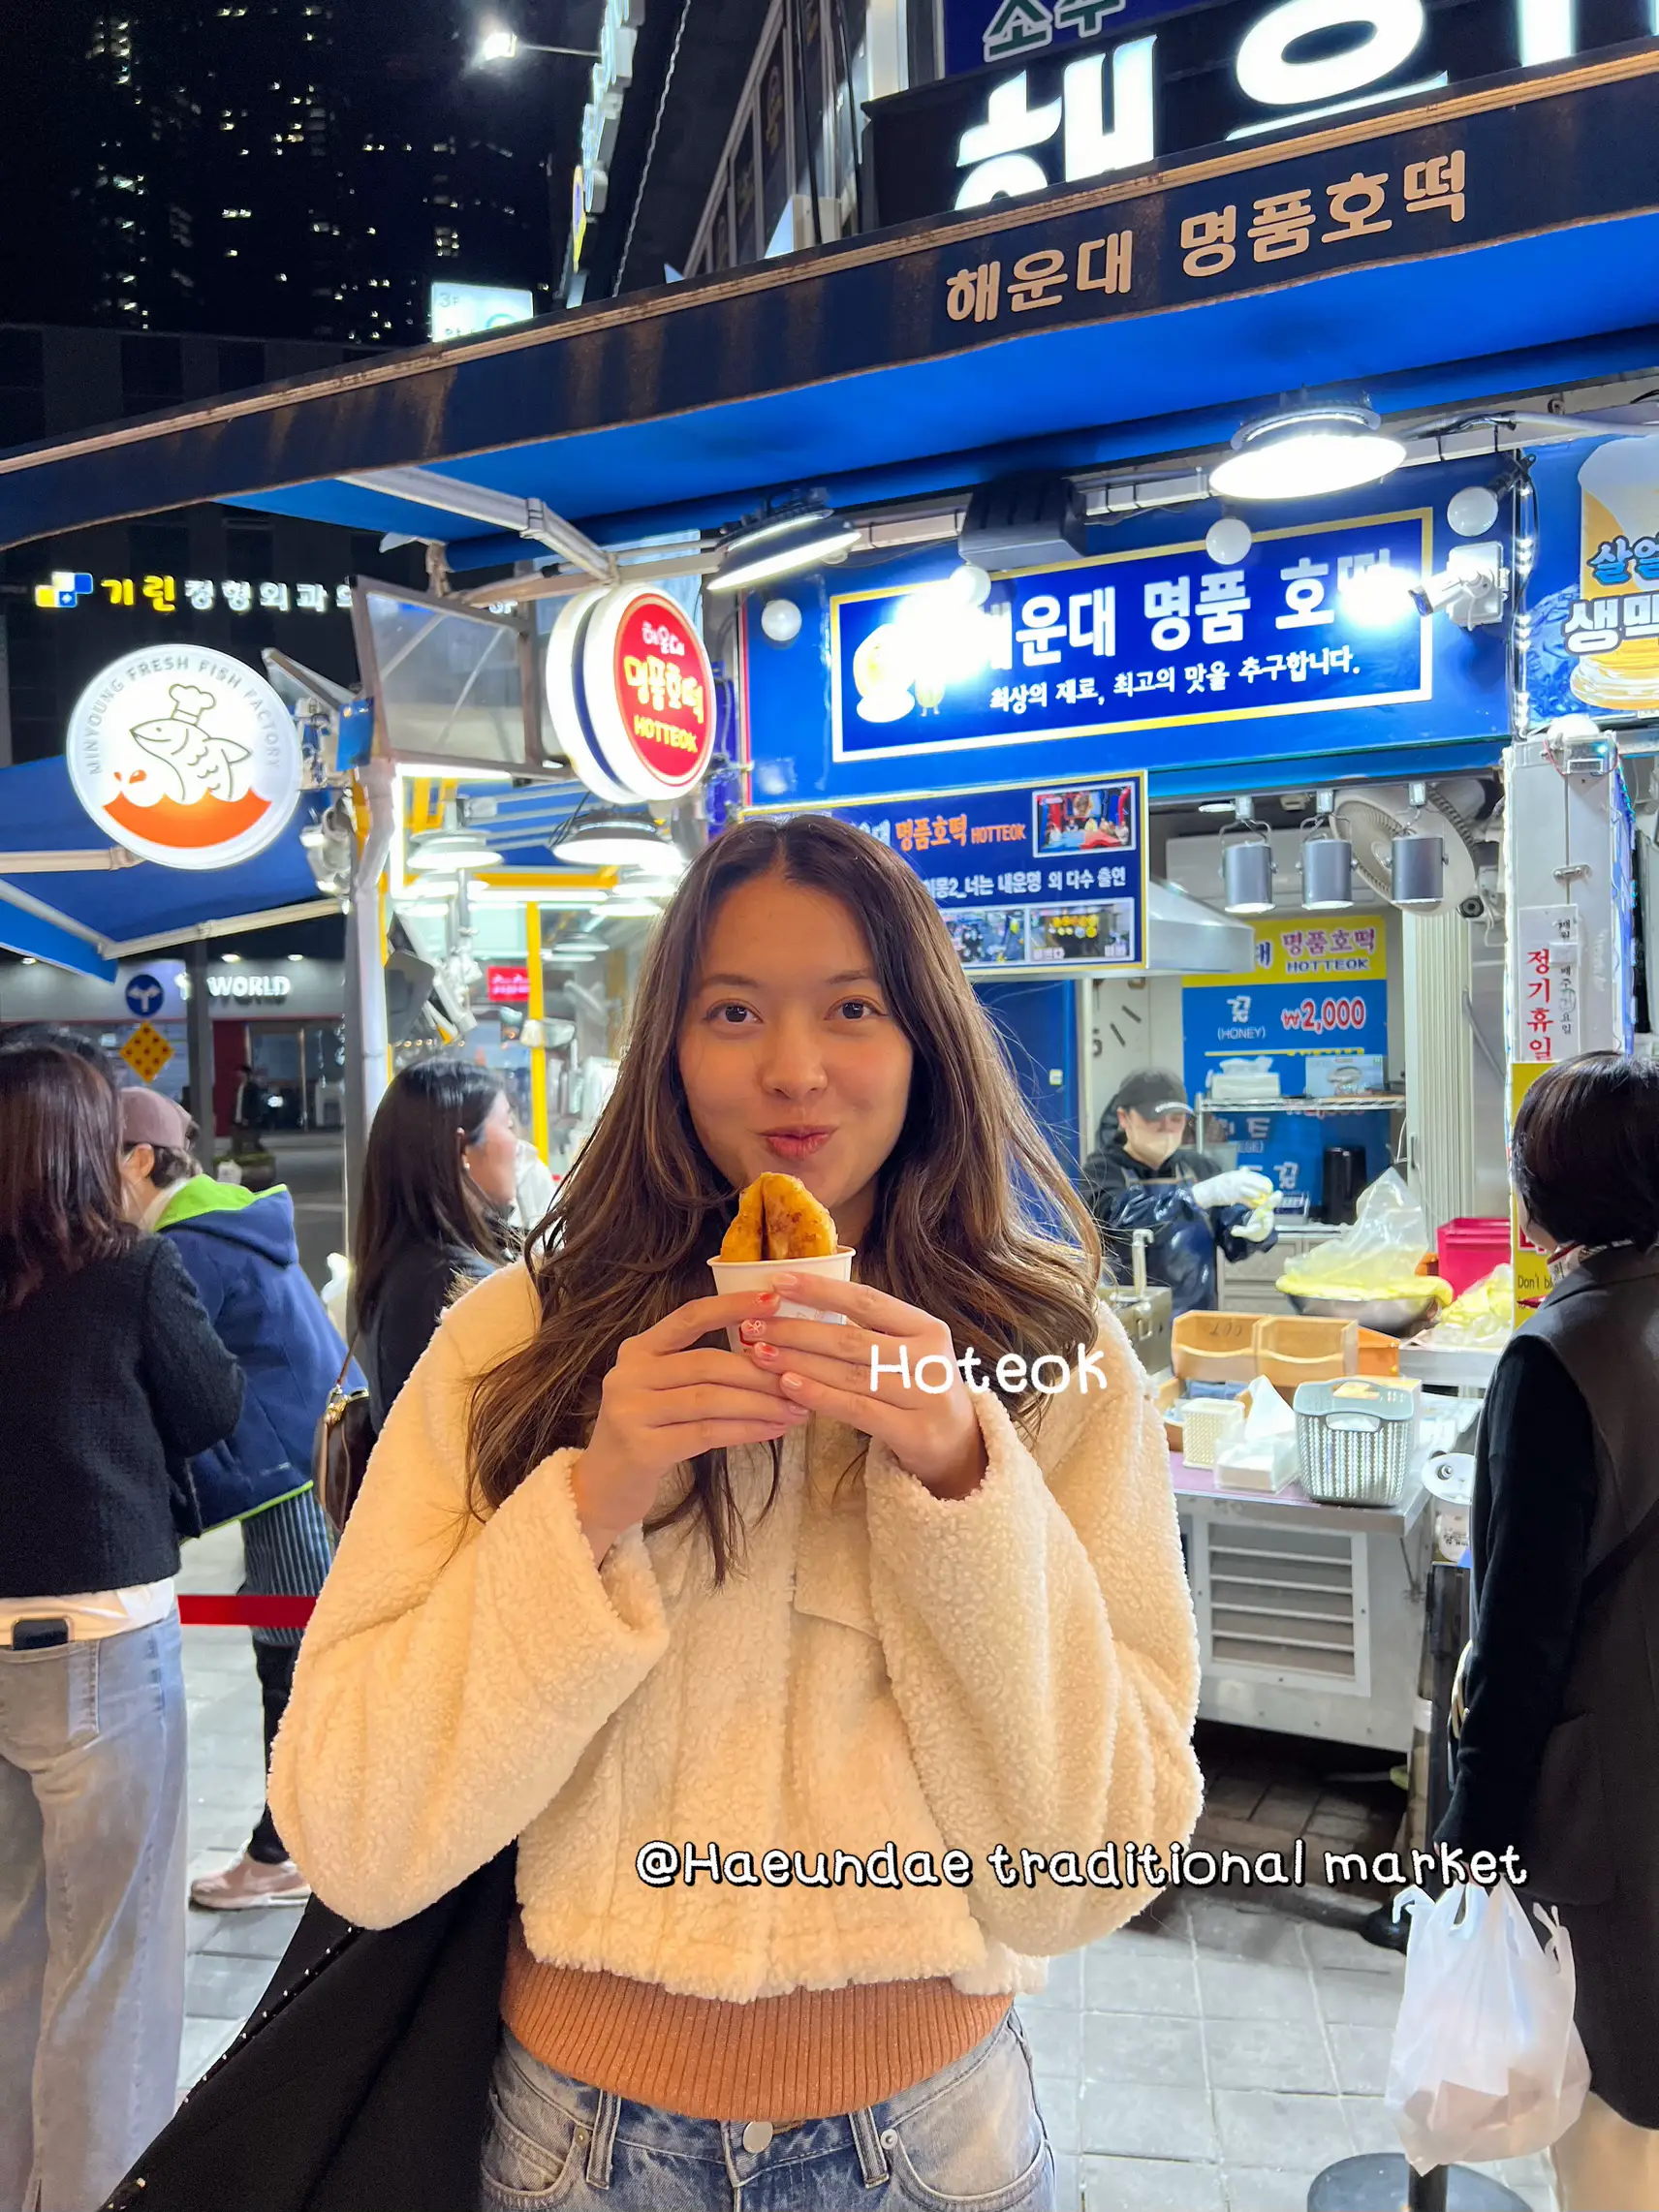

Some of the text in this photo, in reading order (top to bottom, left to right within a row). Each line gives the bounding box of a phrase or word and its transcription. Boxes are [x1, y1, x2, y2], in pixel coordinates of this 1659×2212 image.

[946, 148, 1467, 323] 해운대 명품호떡
[1143, 569, 1253, 654] 명품
[989, 681, 1048, 715] 최상의
[1113, 665, 1176, 698] 최고의
[1183, 660, 1232, 695] 맛을
[1237, 644, 1362, 685] 추구합니다.
[125, 655, 190, 681] FRESH
[198, 659, 242, 689] FISH
[242, 688, 282, 770] FACTORY
[633, 713, 699, 754] HOTTEOK
[894, 813, 968, 852] 명품호떡
[970, 824, 1027, 845] HOTTEOK
[1097, 866, 1127, 888] 출연
[1280, 927, 1376, 957] 명품호떡
[1286, 957, 1371, 974] HOTTEOK
[206, 975, 292, 997] WORLD
[1525, 948, 1554, 1062] 정기휴일
[1217, 1026, 1267, 1042] (HONEY)
[1518, 1271, 1540, 1290] Don't
